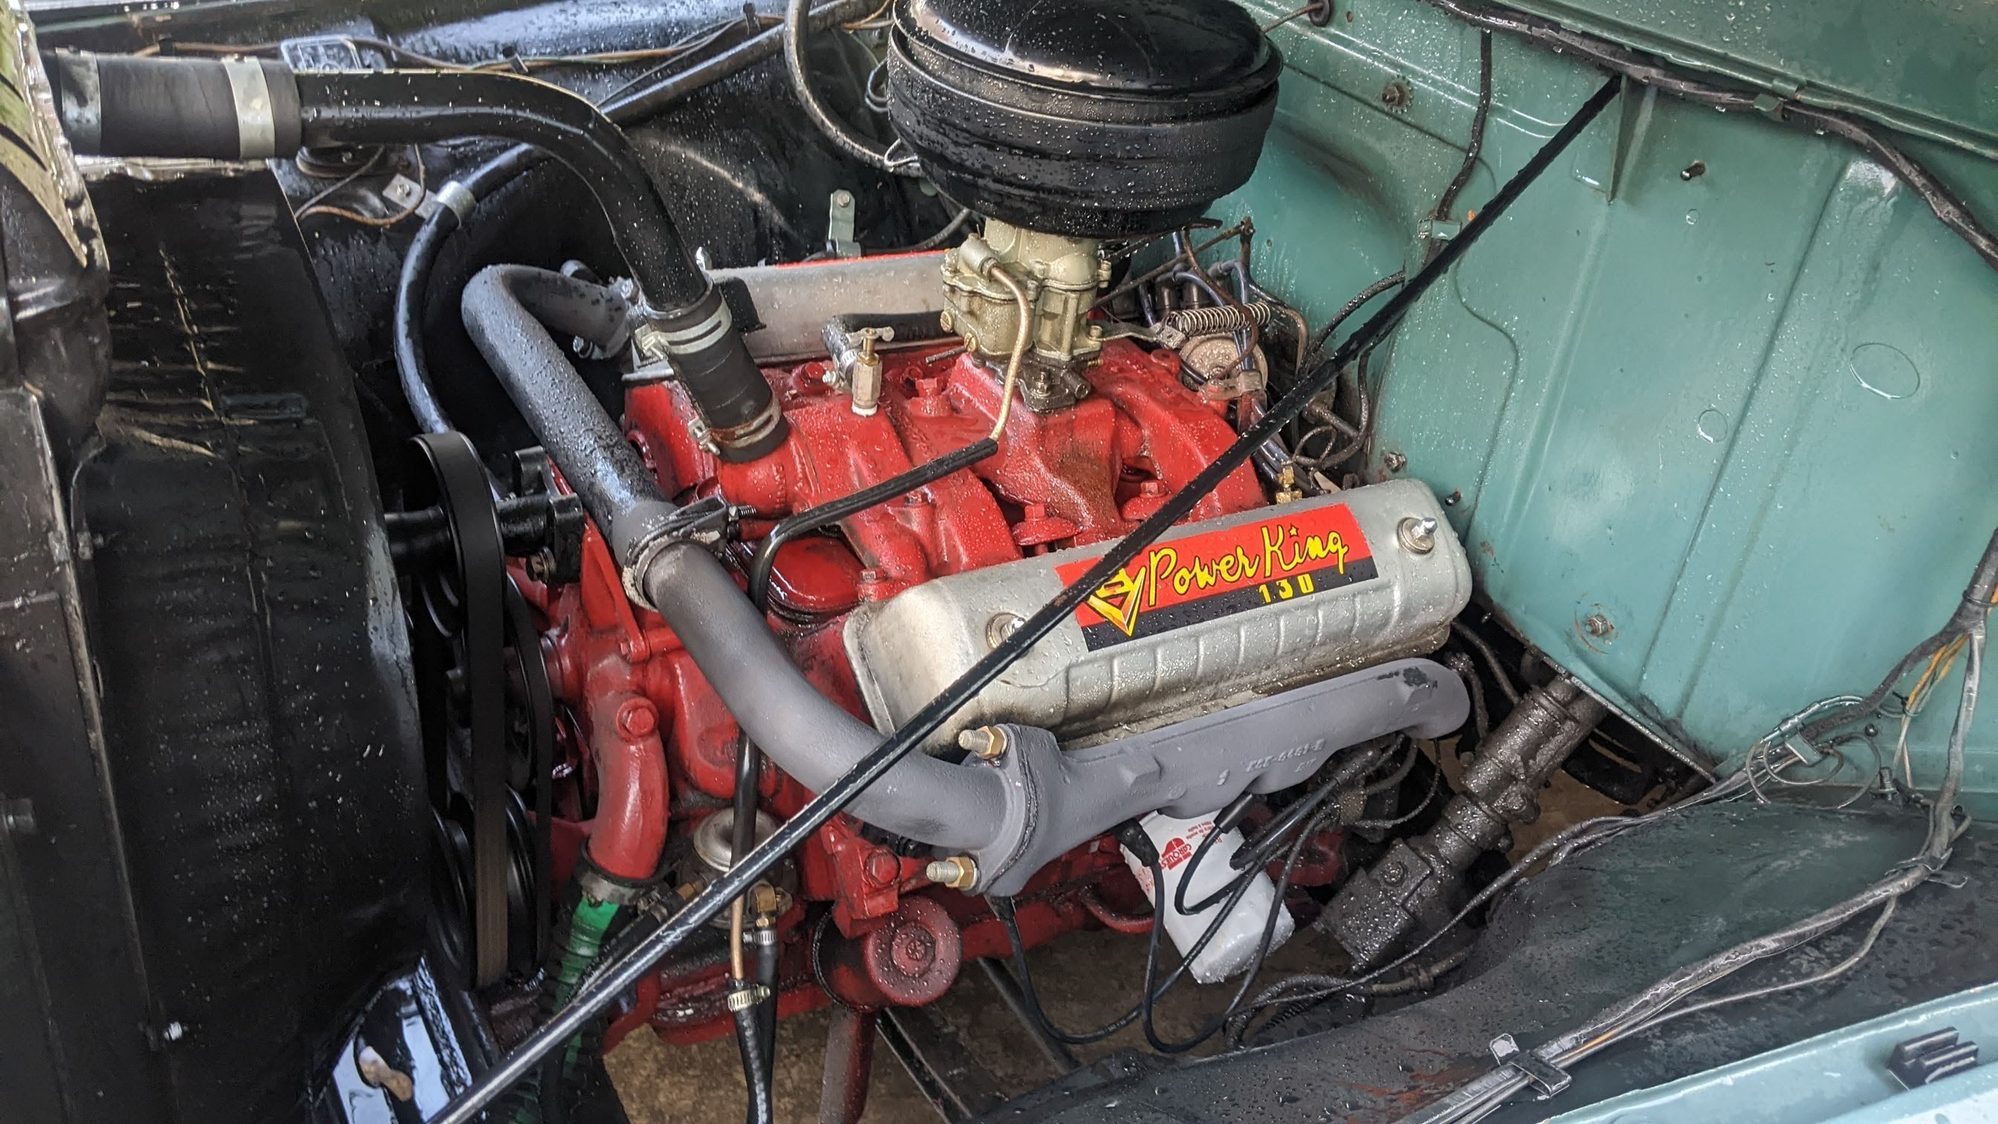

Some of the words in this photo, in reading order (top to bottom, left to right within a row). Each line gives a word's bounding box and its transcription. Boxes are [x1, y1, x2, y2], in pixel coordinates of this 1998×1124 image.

[1148, 546, 1260, 607] Power
[1261, 524, 1349, 578] King
[1258, 573, 1316, 604] 130
[1158, 843, 1192, 869] CARQUES
